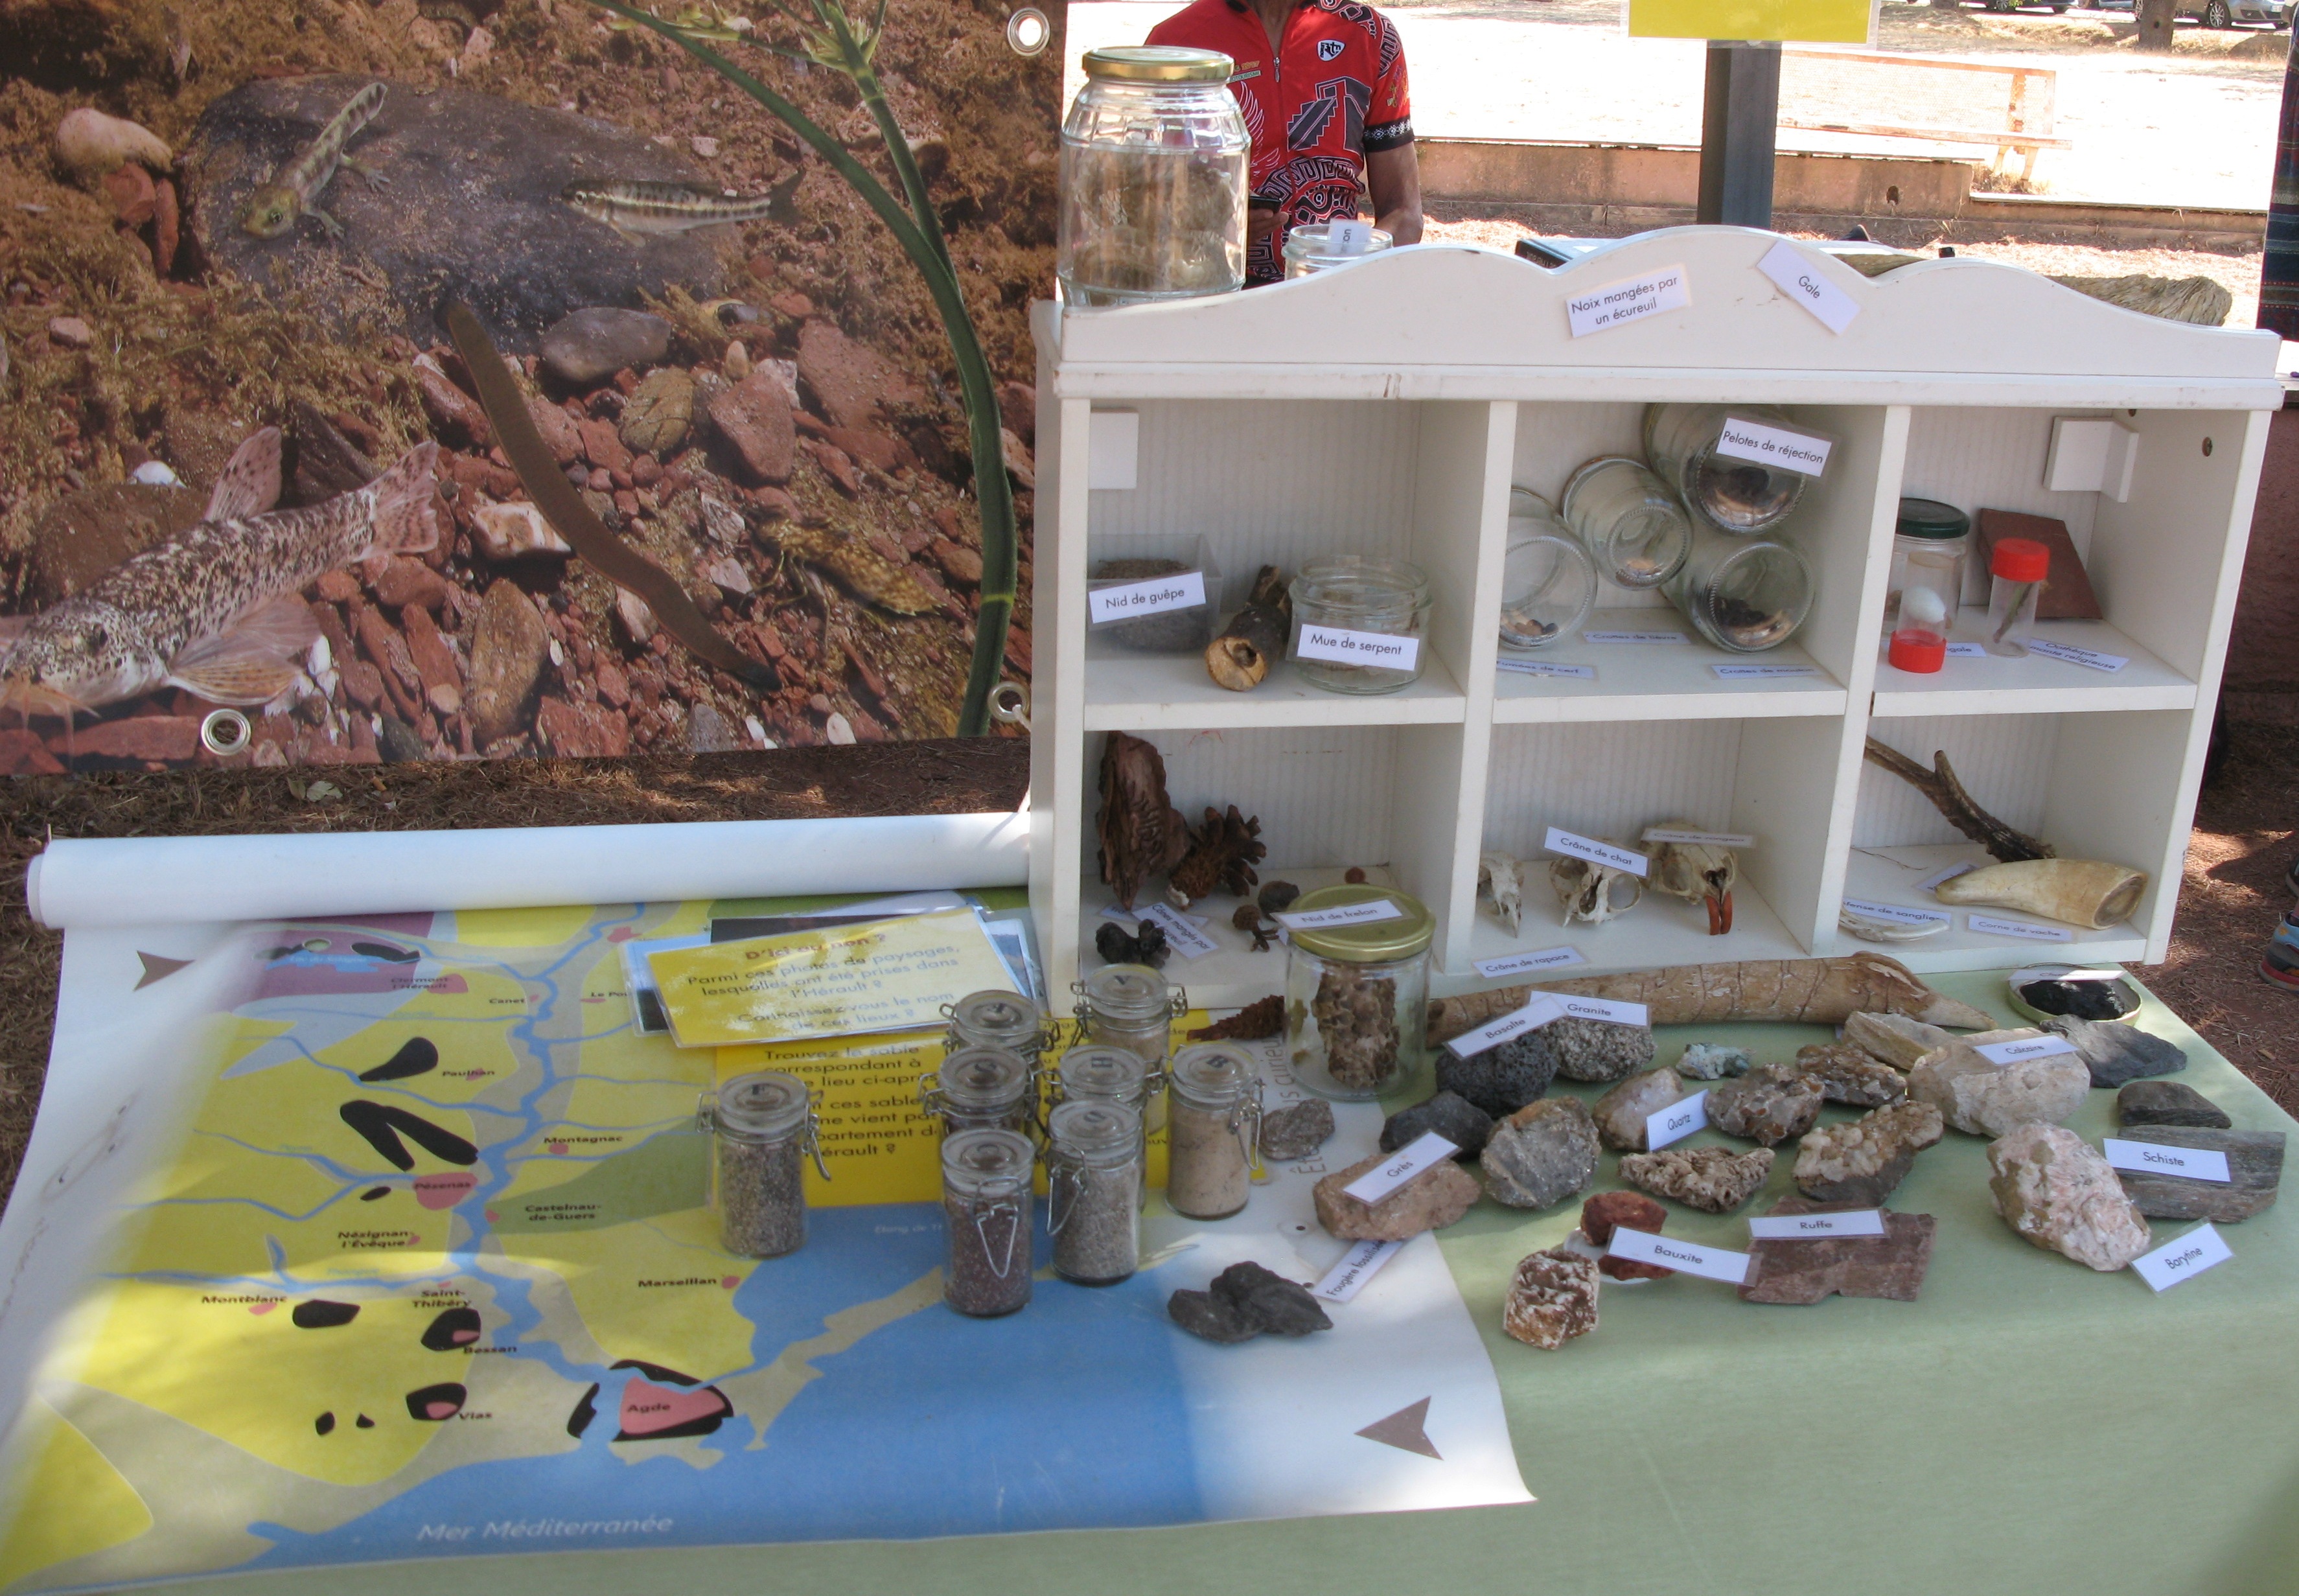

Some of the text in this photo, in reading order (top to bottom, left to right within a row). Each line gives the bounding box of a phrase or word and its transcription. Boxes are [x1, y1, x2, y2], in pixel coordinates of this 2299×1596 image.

[1571, 275, 1678, 314] Noix mangées par
[1798, 275, 1820, 299] Gale
[1595, 296, 1657, 325] un écureuil
[1722, 431, 1823, 463] Pelotes de réjection
[1106, 588, 1185, 608] Nid de guêpe
[1311, 633, 1402, 656] Mue de serpent
[1946, 646, 1972, 654] igale
[2064, 654, 2116, 670] religieuse
[1560, 838, 1633, 866] Crâne de chat
[1344, 908, 1378, 918] frelon
[1843, 901, 1875, 912] fense
[1978, 921, 2011, 931] Corne
[2029, 928, 2061, 938] vache
[1194, 940, 1210, 950] par
[688, 973, 739, 985] Parmi
[844, 956, 866, 966] de
[873, 945, 960, 964] paysages,
[1486, 953, 1569, 973] Crâne de rapace
[702, 980, 789, 996] lesquelles
[827, 971, 854, 982] été
[861, 965, 911, 979] prises
[917, 957, 959, 970] dans
[893, 997, 910, 1005] le
[917, 992, 954, 1003] nom
[1567, 1003, 1612, 1017] Granite
[792, 1019, 814, 1030] de
[821, 1018, 850, 1027] ces
[856, 1012, 899, 1023] lieux
[1485, 1017, 1526, 1039] Basalte
[765, 1046, 919, 1060] Trouvez le sable
[765, 1058, 921, 1074] correspondant à
[822, 1076, 855, 1087] lieu
[830, 1100, 861, 1109] ces
[870, 1094, 921, 1107] sable
[851, 1112, 896, 1124] vient
[1667, 1114, 1691, 1131] Quartz
[544, 1136, 623, 1145] Montagnac
[817, 1126, 913, 1142] partement
[886, 1143, 895, 1154] ?
[2143, 1151, 2185, 1166] Schiste
[1387, 1161, 1413, 1177] Grès
[526, 1203, 601, 1212] Castelnau-
[529, 1211, 595, 1221] de-Guers
[1800, 1221, 1832, 1230] Ruffe
[1654, 1245, 1704, 1264] Bauxite
[2164, 1248, 2202, 1269] Barytine
[638, 1277, 717, 1288] Marseillan
[202, 1295, 287, 1304] Montblanc
[412, 1299, 472, 1308] Thibéry
[463, 1345, 517, 1354] Bessan
[459, 1411, 492, 1420] Vias
[627, 1403, 671, 1413] Agde
[417, 1516, 673, 1542] Mer Méditerranée
